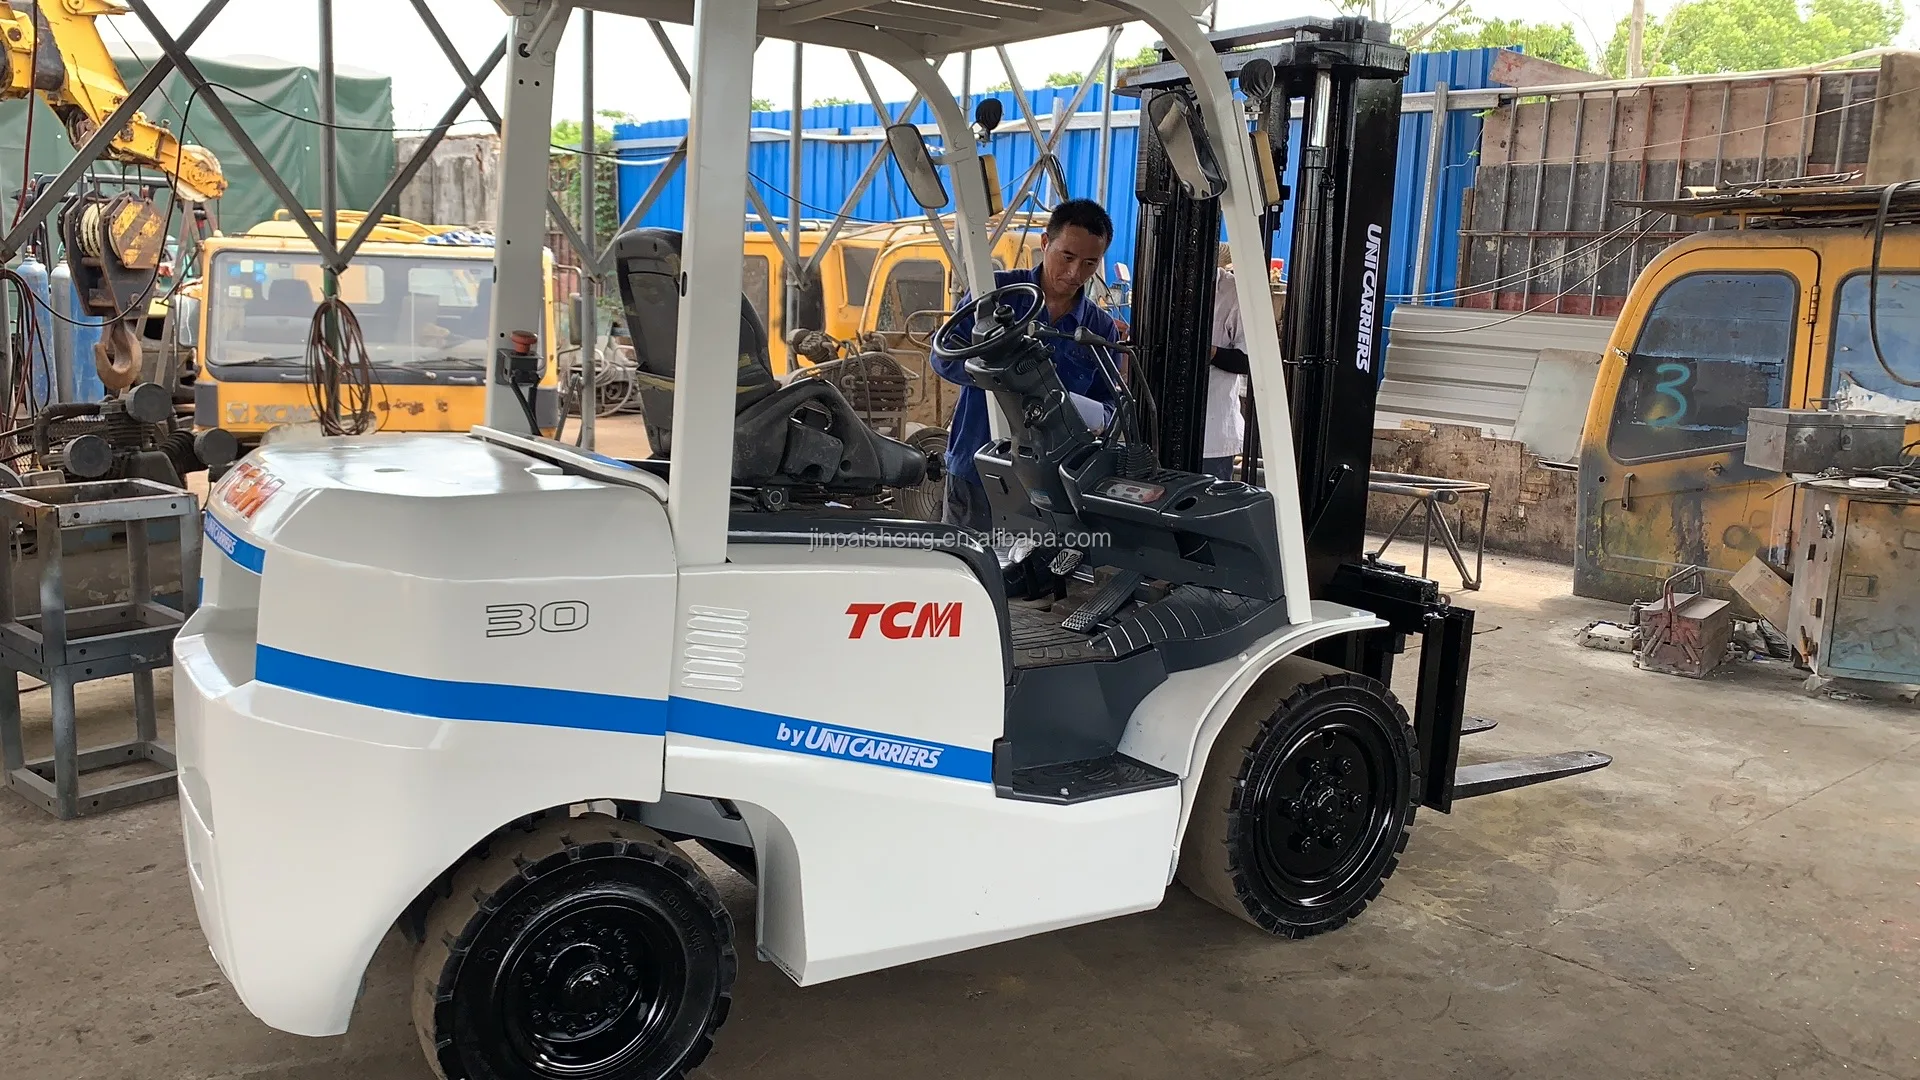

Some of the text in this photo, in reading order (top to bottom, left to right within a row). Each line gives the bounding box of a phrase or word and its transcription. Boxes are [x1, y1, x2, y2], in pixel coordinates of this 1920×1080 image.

[1355, 223, 1383, 373] UNICARRIERS
[1654, 363, 1691, 427] 3
[486, 600, 589, 638] 30
[845, 601, 963, 639] TCM
[776, 722, 944, 769] by UNICARRIERS
